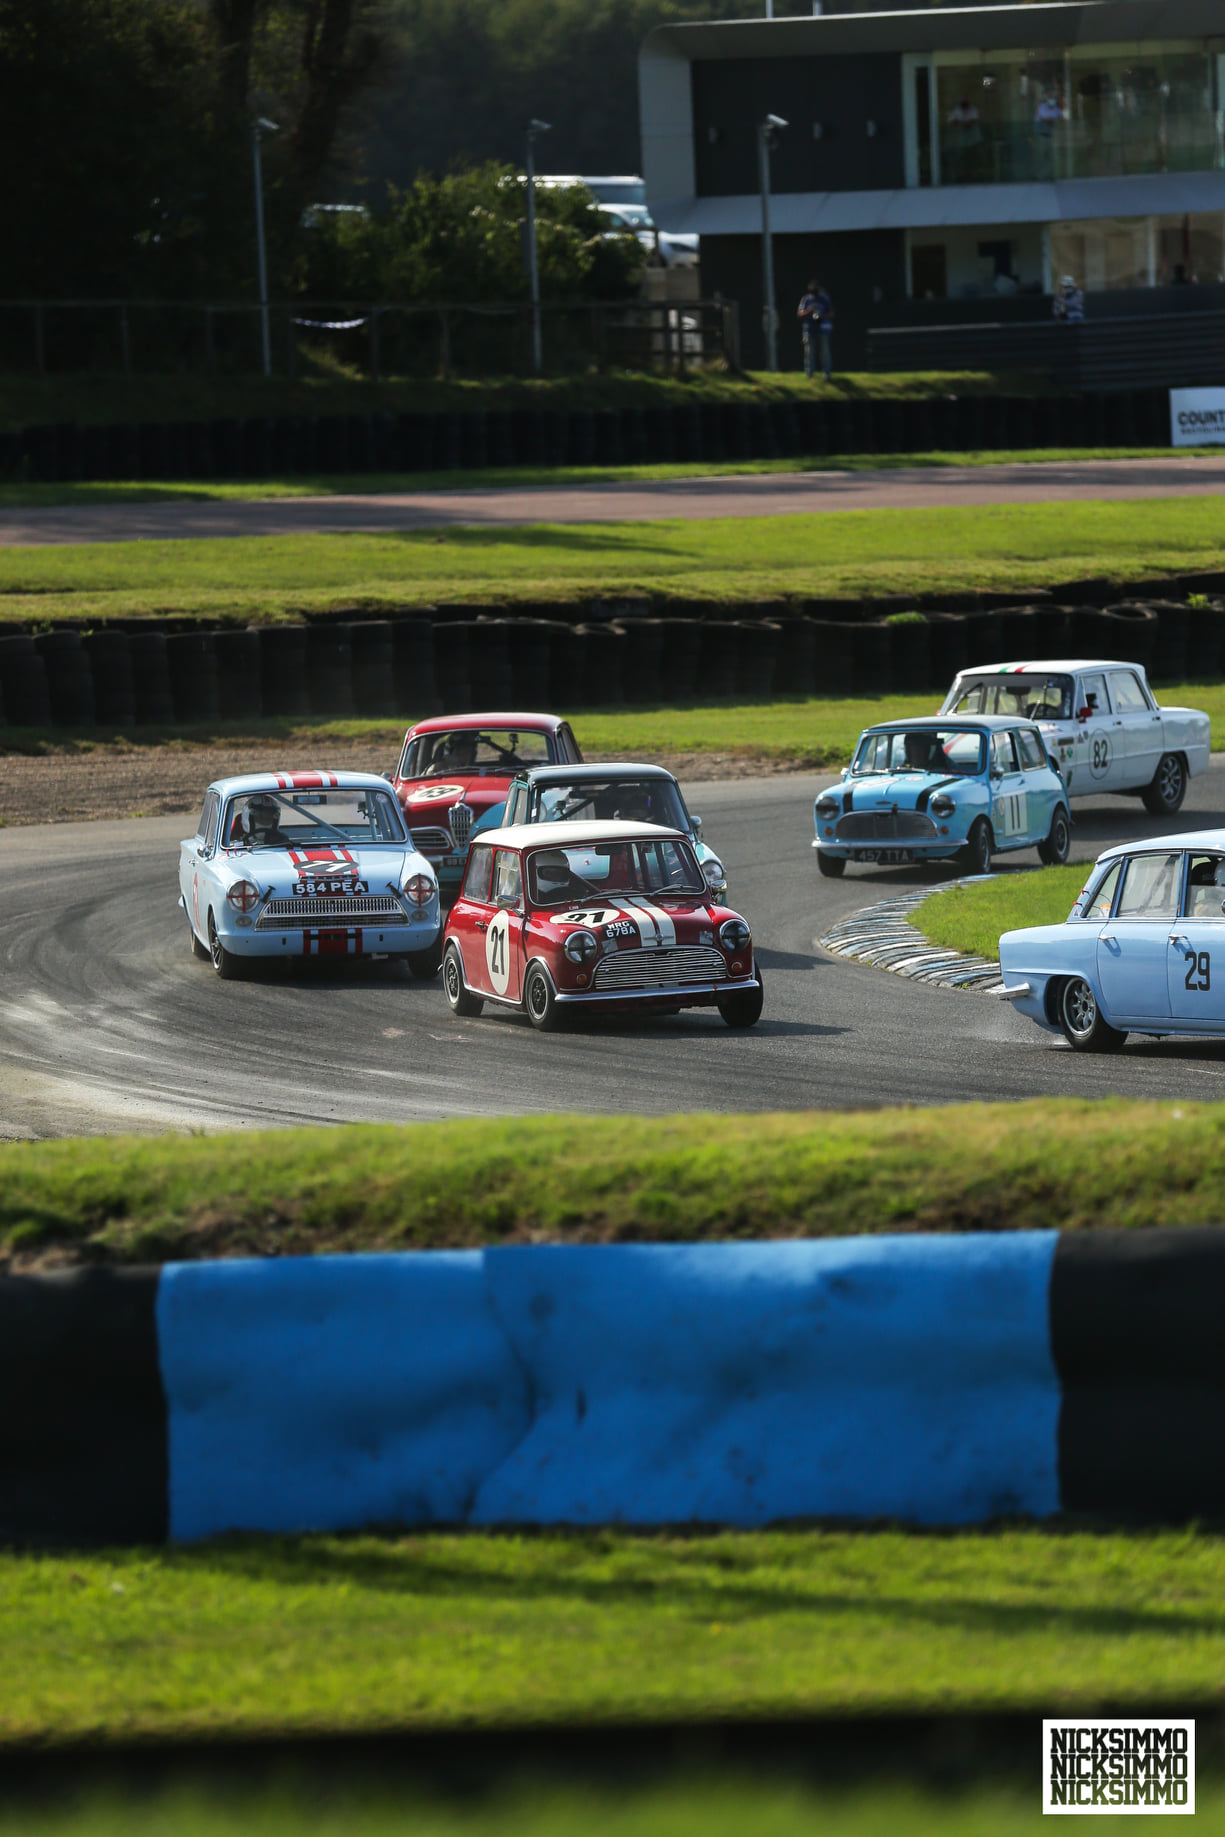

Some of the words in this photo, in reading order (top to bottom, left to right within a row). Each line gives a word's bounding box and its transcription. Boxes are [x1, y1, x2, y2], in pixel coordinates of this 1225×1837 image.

[1093, 740, 1108, 769] 82
[1010, 795, 1021, 831] 11
[296, 883, 327, 895] 584
[331, 882, 366, 893] PEA
[563, 911, 606, 924] 21
[606, 926, 636, 938] 678A
[490, 925, 505, 976] 21
[1185, 951, 1210, 992] 29
